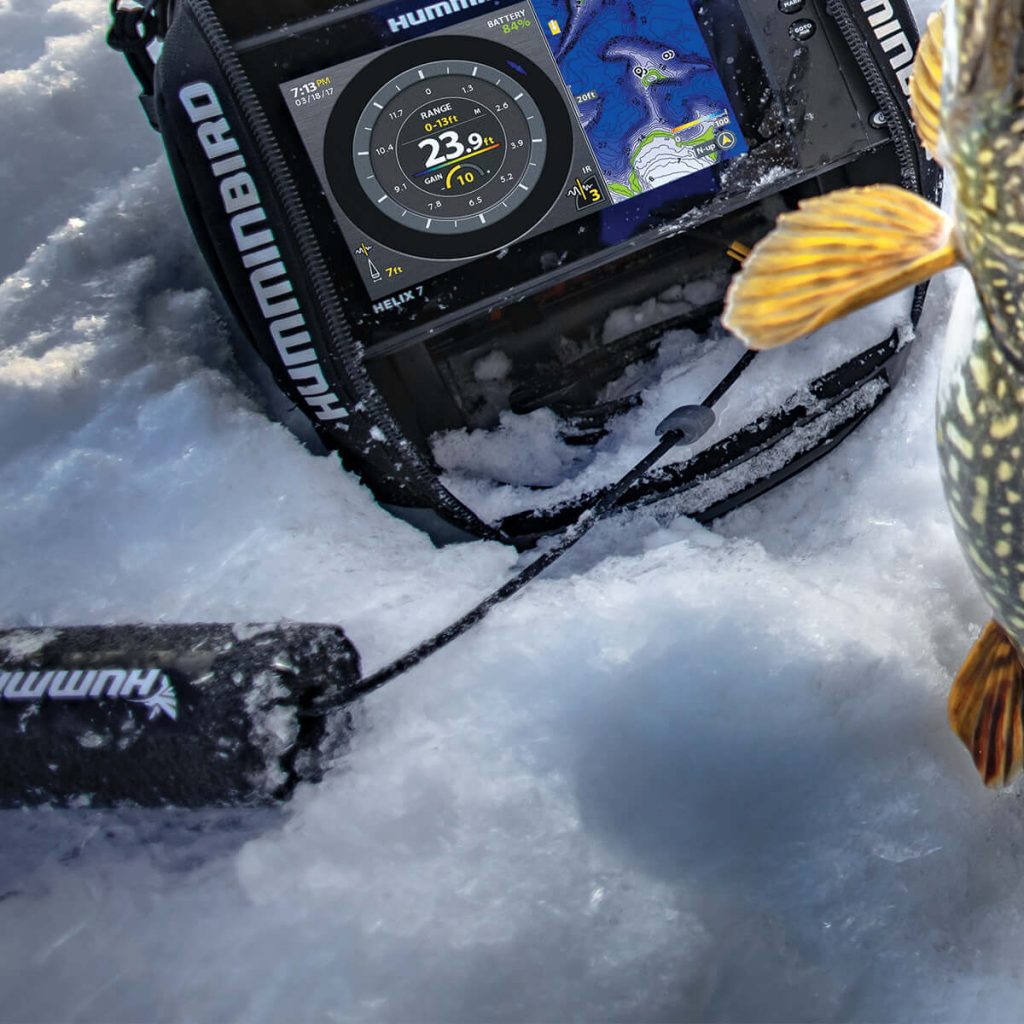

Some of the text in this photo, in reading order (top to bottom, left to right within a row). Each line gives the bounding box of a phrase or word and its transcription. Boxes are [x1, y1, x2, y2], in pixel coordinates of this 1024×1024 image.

[486, 9, 527, 28] BATTERY
[502, 17, 531, 34] 84%
[794, 22, 812, 33] GOTO
[424, 87, 433, 96] 0
[461, 84, 475, 94] 1.3
[576, 90, 598, 104] 20ft
[420, 102, 453, 120] RANGE
[473, 107, 482, 116] M
[494, 101, 509, 113] 2.6
[388, 109, 404, 121] 11.7
[424, 114, 459, 133] 0-13ft
[375, 143, 394, 156] 10.4
[510, 139, 524, 150] 3.9
[696, 143, 717, 156] N-up
[581, 165, 593, 175] IR
[424, 172, 444, 185] GAIN
[456, 171, 475, 187] 10
[500, 172, 514, 183] 5.2
[394, 182, 408, 193] 9.1
[468, 196, 483, 207] 6.5
[589, 188, 602, 202] 3
[427, 200, 442, 211] 7.8
[179, 80, 349, 420] HUMMINBIRD
[385, 265, 403, 278] 7ft
[371, 285, 424, 314] HELIX 7
